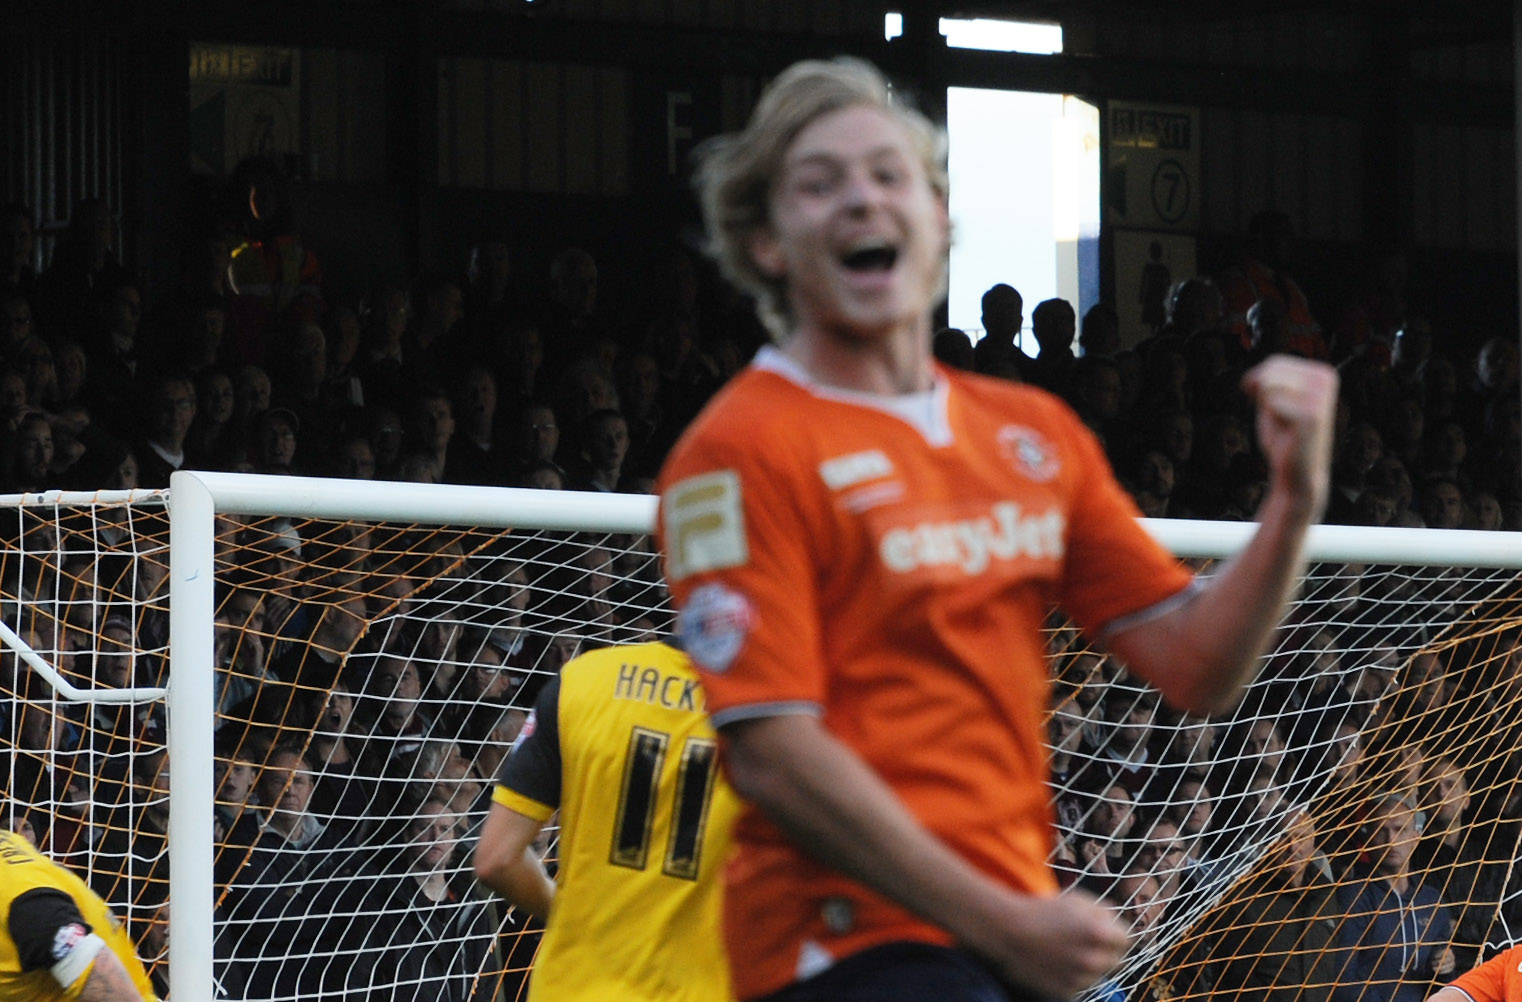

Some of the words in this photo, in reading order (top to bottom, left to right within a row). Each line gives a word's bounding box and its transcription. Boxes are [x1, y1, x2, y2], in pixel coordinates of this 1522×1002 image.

[667, 91, 692, 176] F
[1163, 173, 1180, 213] 7
[879, 502, 1065, 574] easyJet
[614, 664, 709, 714] HACK
[609, 726, 717, 881] 11
